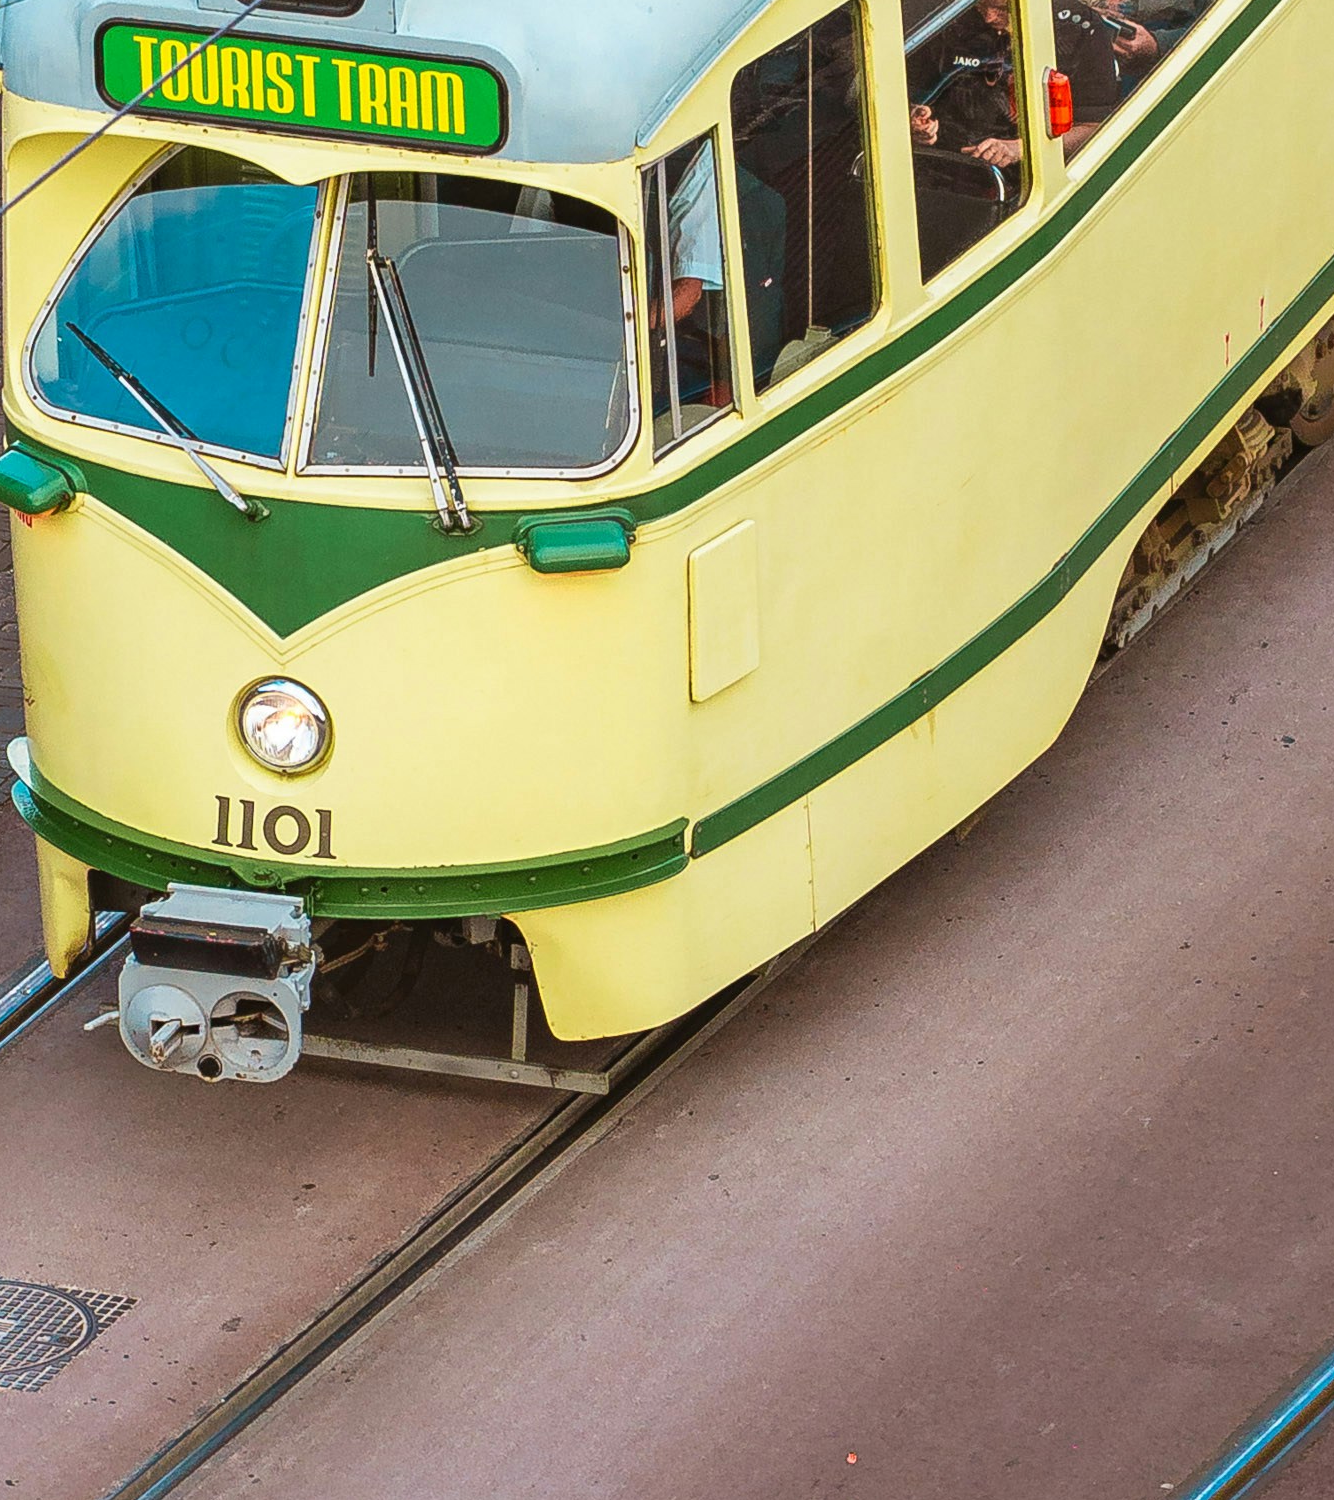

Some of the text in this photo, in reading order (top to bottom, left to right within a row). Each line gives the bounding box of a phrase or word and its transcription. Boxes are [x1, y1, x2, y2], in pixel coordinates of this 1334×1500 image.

[133, 35, 465, 136] TOURIST TRAM
[953, 55, 980, 67] JAKO
[212, 795, 337, 859] 1101
